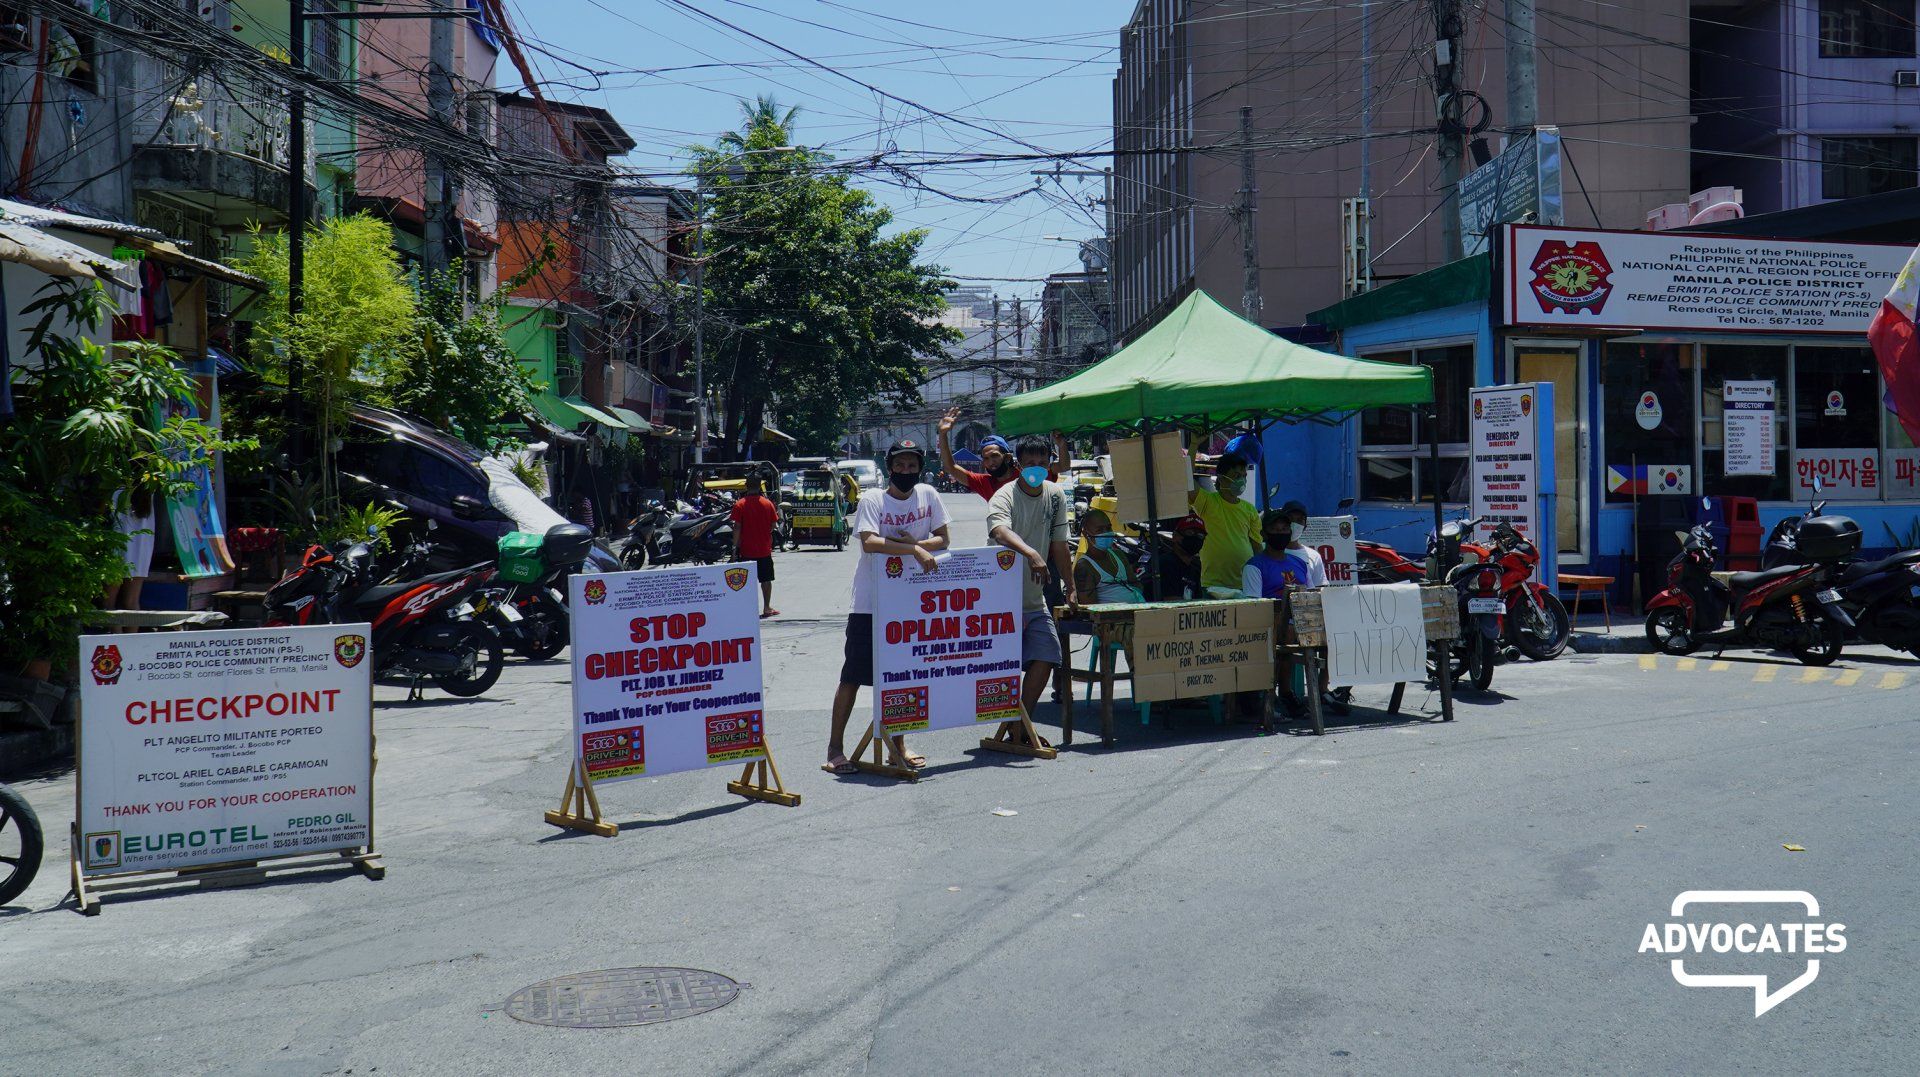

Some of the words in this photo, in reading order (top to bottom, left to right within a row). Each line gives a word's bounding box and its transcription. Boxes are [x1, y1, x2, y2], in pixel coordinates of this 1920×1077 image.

[1684, 245, 1740, 254] Republic
[1746, 247, 1758, 256] of
[1786, 250, 1854, 259] Philippines
[1670, 254, 1745, 264] PHILIPPINE
[1749, 258, 1816, 267] NATIONAL
[1820, 260, 1867, 268] POLICE
[1622, 262, 1692, 272] NATIONAL
[1696, 265, 1753, 274] CAPITAL
[1758, 267, 1808, 276] REGION
[1813, 269, 1860, 278] POLICE
[1864, 271, 1901, 279] OFFIC
[1673, 275, 1732, 284] MANILA
[1738, 278, 1792, 286] POLICE
[1797, 280, 1864, 288] DISTRICT
[1667, 286, 1718, 294] ERMITA
[1722, 288, 1772, 296] POLICE
[1776, 289, 1830, 298] STATION
[1627, 294, 1700, 303] REMEDIOS
[1704, 296, 1755, 305] POLICE
[1759, 298, 1840, 308] COMMUNITY
[1843, 301, 1882, 309] PRECI
[1668, 305, 1733, 314] Remedios
[1737, 307, 1778, 316] Circle,
[1782, 308, 1826, 318] Malate,
[1830, 309, 1870, 318] Manila
[1797, 458, 1878, 488] 한인자율
[920, 588, 980, 614] STOP
[1358, 586, 1396, 624] NO
[630, 612, 706, 643] STOP
[886, 617, 960, 644] OPLAN
[965, 612, 1015, 637] SITA
[1179, 609, 1227, 630] ENTRANCE
[169, 640, 206, 649] MANILA
[209, 639, 244, 647] POLICE
[247, 637, 290, 646] DISTRICT
[912, 646, 929, 656] PLT.
[930, 643, 946, 655] JOB
[948, 642, 956, 653] V.
[958, 639, 992, 652] JIMENEZ
[1164, 641, 1194, 658] OROSA
[1334, 625, 1422, 676] ENTRY
[196, 649, 230, 658] POLICE
[234, 647, 274, 656] STATION
[277, 646, 304, 654] (PS-5)
[585, 637, 754, 680] CHECKPOINT
[939, 652, 983, 661] COMMANDER
[1180, 657, 1192, 668] FOR
[1196, 654, 1224, 666] THERMAL
[1229, 651, 1248, 662] SCAN
[139, 662, 182, 670] BOCOBO
[186, 659, 220, 668] POLICE
[224, 656, 280, 666] COMMUNITY
[283, 654, 330, 662] PRECINCT
[227, 668, 253, 676] Flores
[269, 666, 298, 674] Ermita,
[302, 664, 328, 672] Manila
[883, 670, 911, 683] Thank
[912, 668, 929, 680] You
[930, 667, 945, 678] For
[946, 664, 966, 676] Your
[967, 660, 1020, 674] Cooperation
[622, 679, 642, 692] PLT.
[644, 676, 665, 690] JOB
[667, 674, 678, 686] V.
[679, 669, 724, 685] JIMENEZ
[656, 684, 712, 697] COMMANDER
[125, 689, 341, 725] CHECKPOINT
[584, 708, 620, 724] Thank
[622, 705, 643, 719] You
[646, 702, 663, 716] For
[665, 700, 691, 714] Your
[693, 692, 761, 710] Cooperation
[144, 738, 164, 746] PLT
[167, 734, 220, 745] ANGELITO
[224, 730, 277, 740] MILITANTE
[281, 726, 322, 736] PORTEO
[709, 731, 748, 743] DRIVE-IN
[586, 748, 629, 761] DRIVE-IN
[138, 772, 180, 782] PLTCOL
[183, 769, 213, 778] ARIEL
[217, 764, 266, 776] CABARLE
[269, 759, 328, 771] CARAMOAN
[104, 804, 150, 817] THANK
[156, 801, 184, 812] YOU
[188, 798, 216, 810] FOR
[219, 794, 258, 807] YOUR
[262, 785, 356, 803] COOPERATION
[288, 815, 332, 828] PEDRO
[335, 813, 356, 823] GIL
[124, 825, 268, 853] EUROTEL
[157, 852, 188, 860] service
[192, 849, 207, 857] and
[211, 845, 243, 853] comfort
[247, 842, 268, 850] meet
